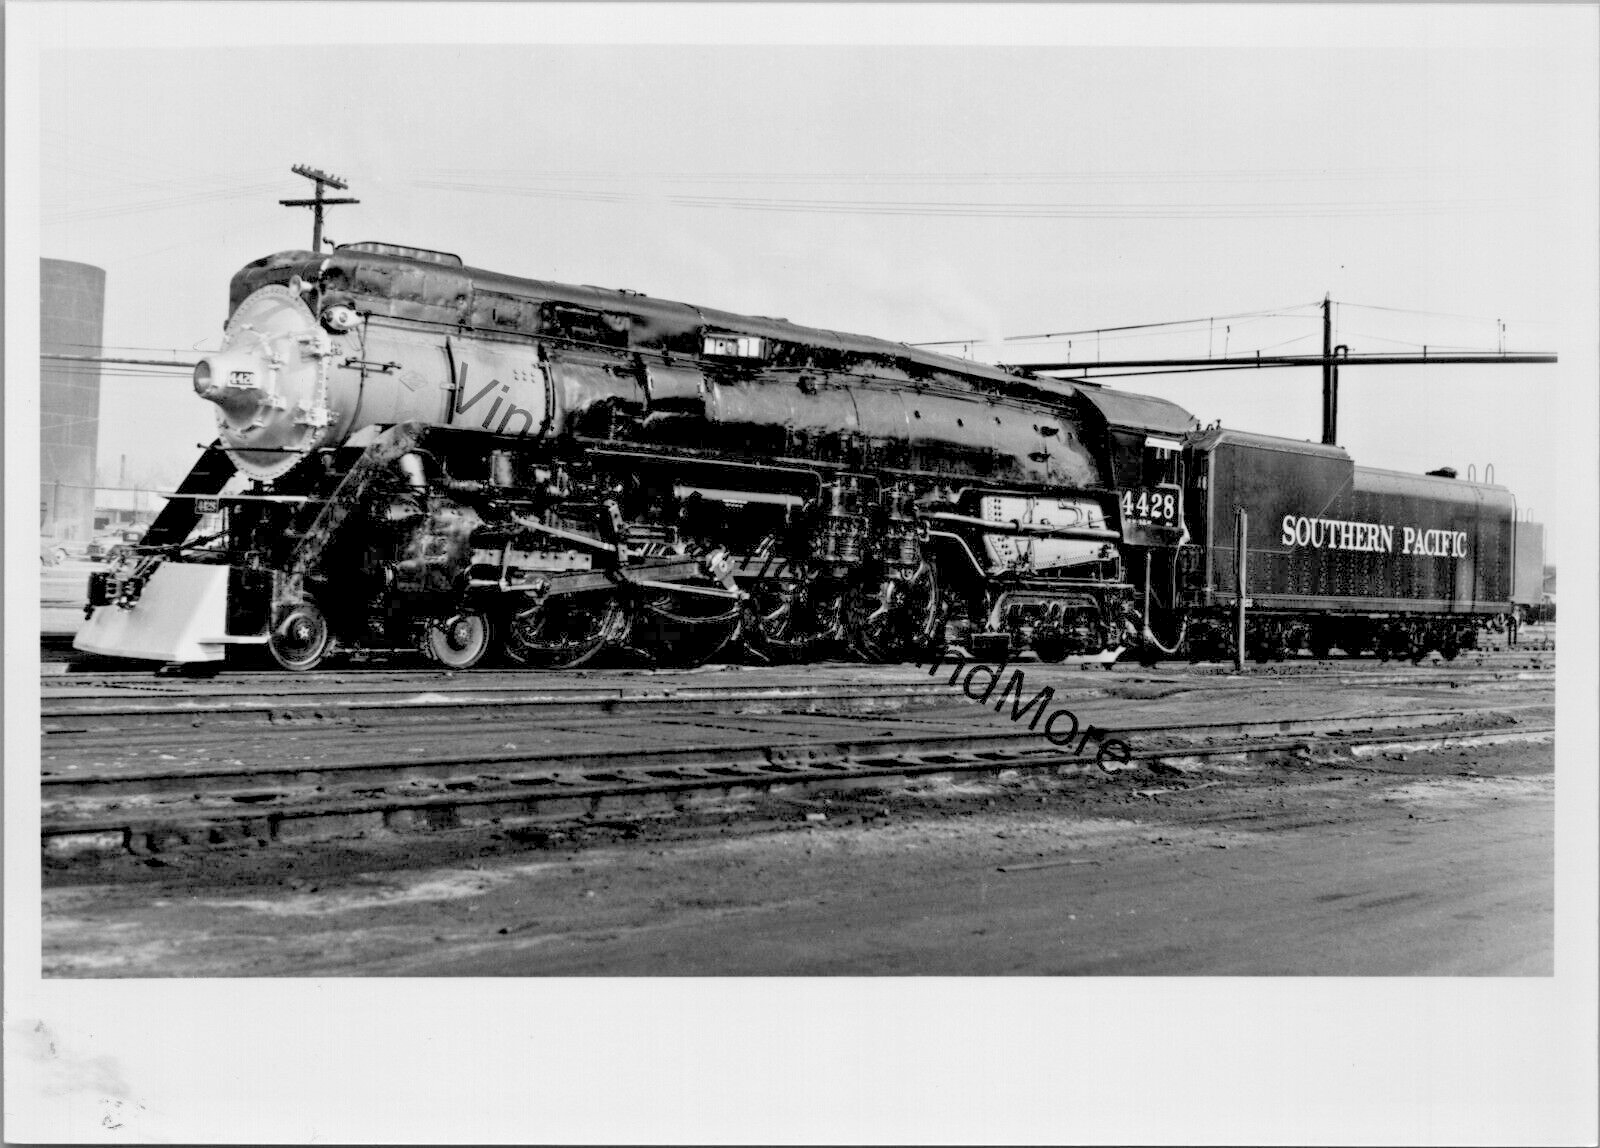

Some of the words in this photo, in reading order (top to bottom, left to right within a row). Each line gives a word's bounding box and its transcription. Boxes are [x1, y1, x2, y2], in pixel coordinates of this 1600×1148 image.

[1122, 490, 1174, 519] 4428
[1282, 514, 1394, 552] SOUTHERN
[1402, 526, 1467, 557] PACIFIC
